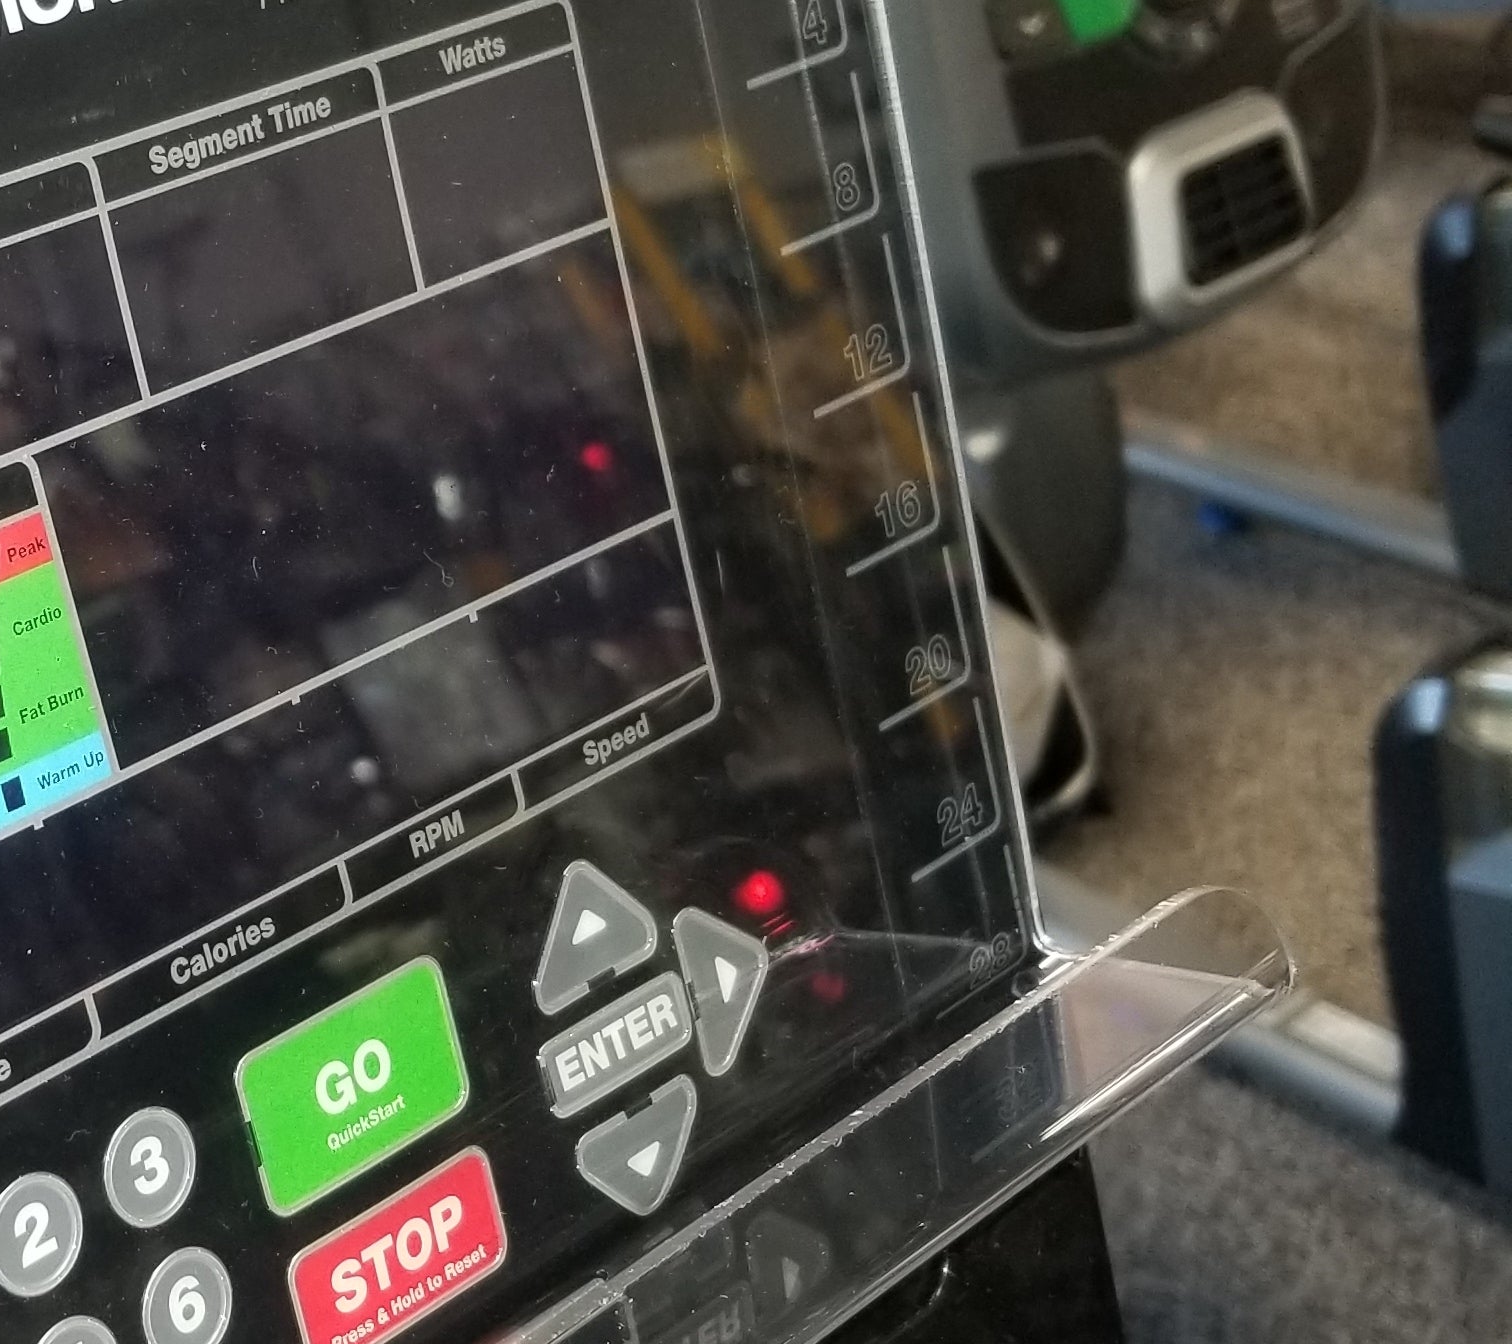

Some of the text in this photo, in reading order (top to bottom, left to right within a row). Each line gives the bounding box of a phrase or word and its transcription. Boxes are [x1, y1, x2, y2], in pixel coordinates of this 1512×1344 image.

[439, 33, 507, 76] Watts
[148, 92, 333, 175] Segment Time
[832, 162, 860, 212] 8
[841, 323, 893, 384] 12
[873, 479, 922, 540] 16
[6, 534, 47, 564] Peak
[11, 605, 64, 637] Cardio
[903, 632, 953, 696] 20
[18, 700, 46, 725] Fat
[47, 684, 86, 714] Burn
[36, 762, 82, 791] Warm
[82, 749, 106, 771] Up
[580, 710, 653, 769] Speed
[406, 808, 467, 860] RPM
[935, 781, 986, 847] 24
[168, 909, 278, 987] Calories
[554, 993, 680, 1092] ENTER
[314, 1037, 393, 1116] GO
[324, 1092, 407, 1153] QuickStart
[13, 1201, 60, 1269] 2
[134, 1135, 170, 1195] 3
[330, 1192, 464, 1316] STOP
[376, 1306, 389, 1327] &
[389, 1283, 427, 1321] Hold
[427, 1271, 444, 1293] to
[444, 1242, 487, 1284] Reset
[169, 1275, 207, 1333] 6
